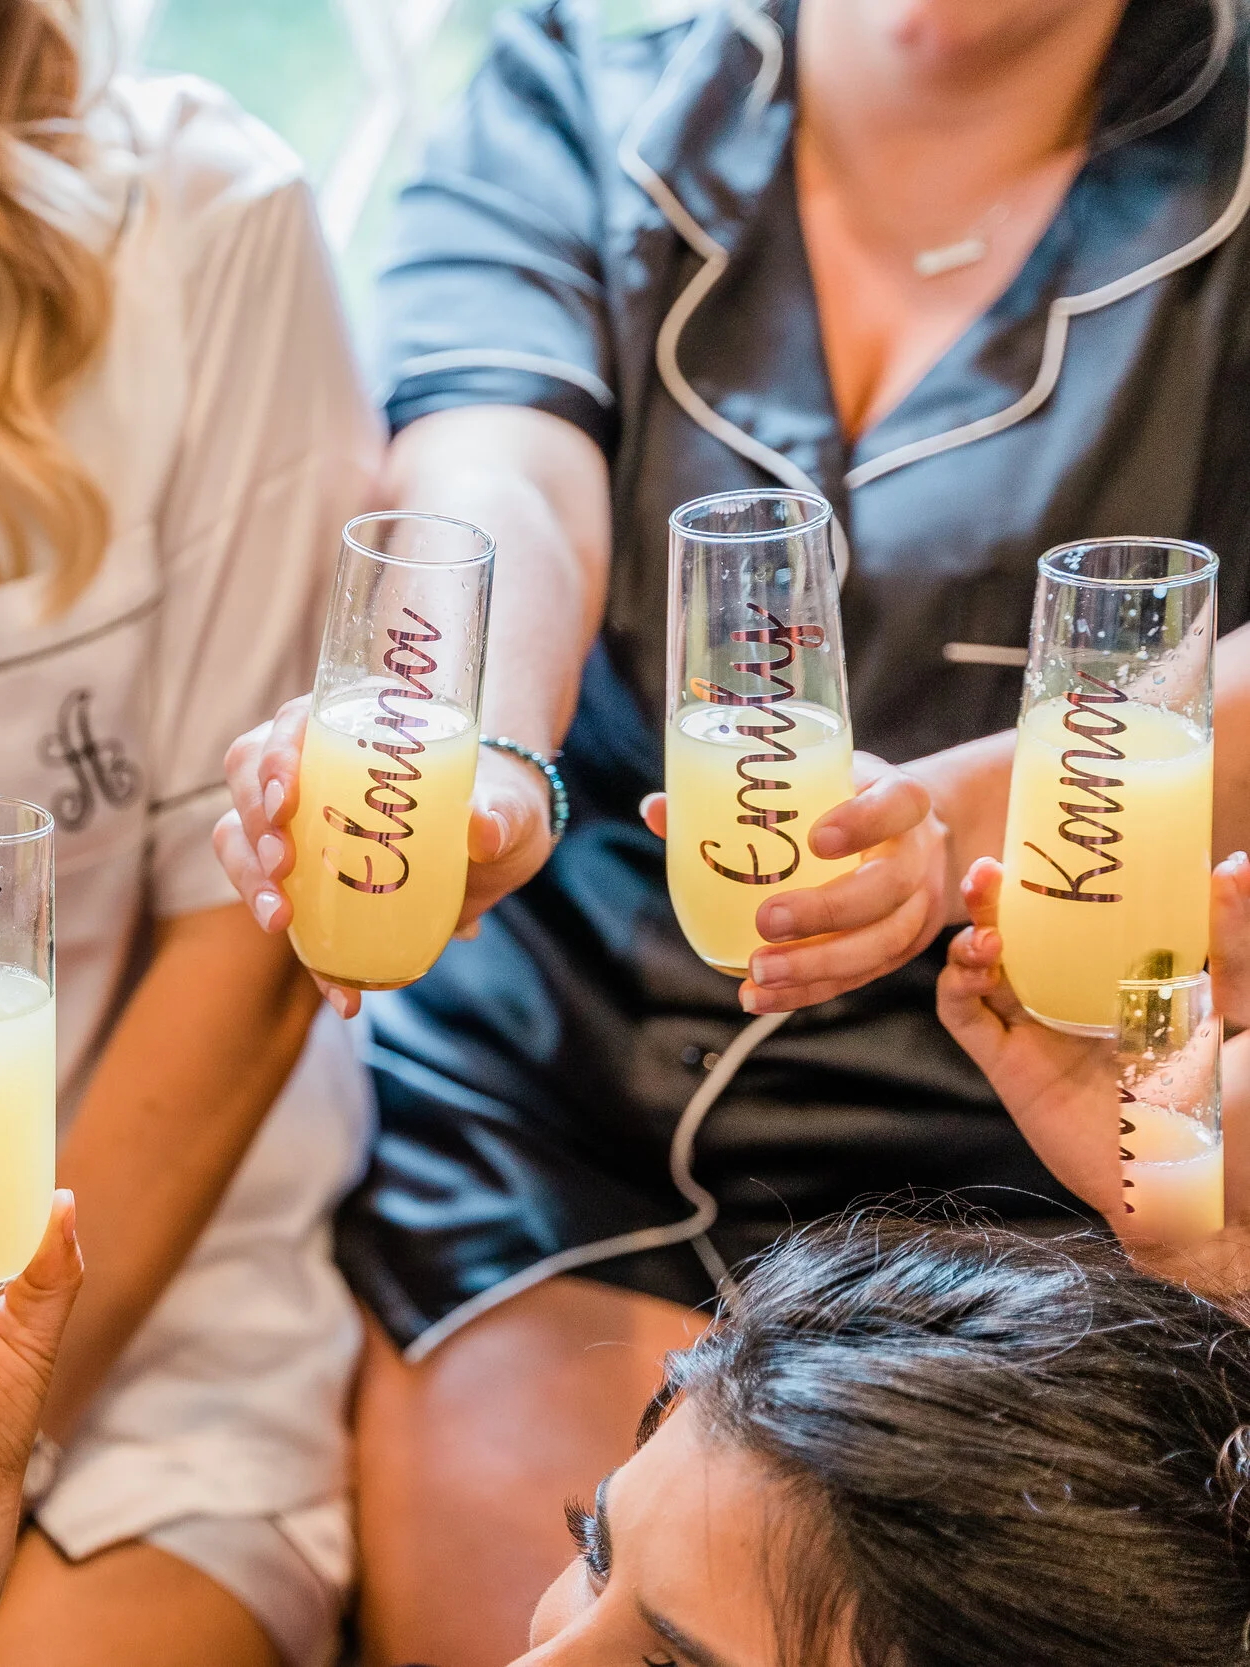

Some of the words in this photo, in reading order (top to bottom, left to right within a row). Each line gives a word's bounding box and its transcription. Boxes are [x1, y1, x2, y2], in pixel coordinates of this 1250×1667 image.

[321, 607, 443, 894] Elaina
[689, 603, 825, 885] Emily
[1021, 671, 1129, 904] Kana
